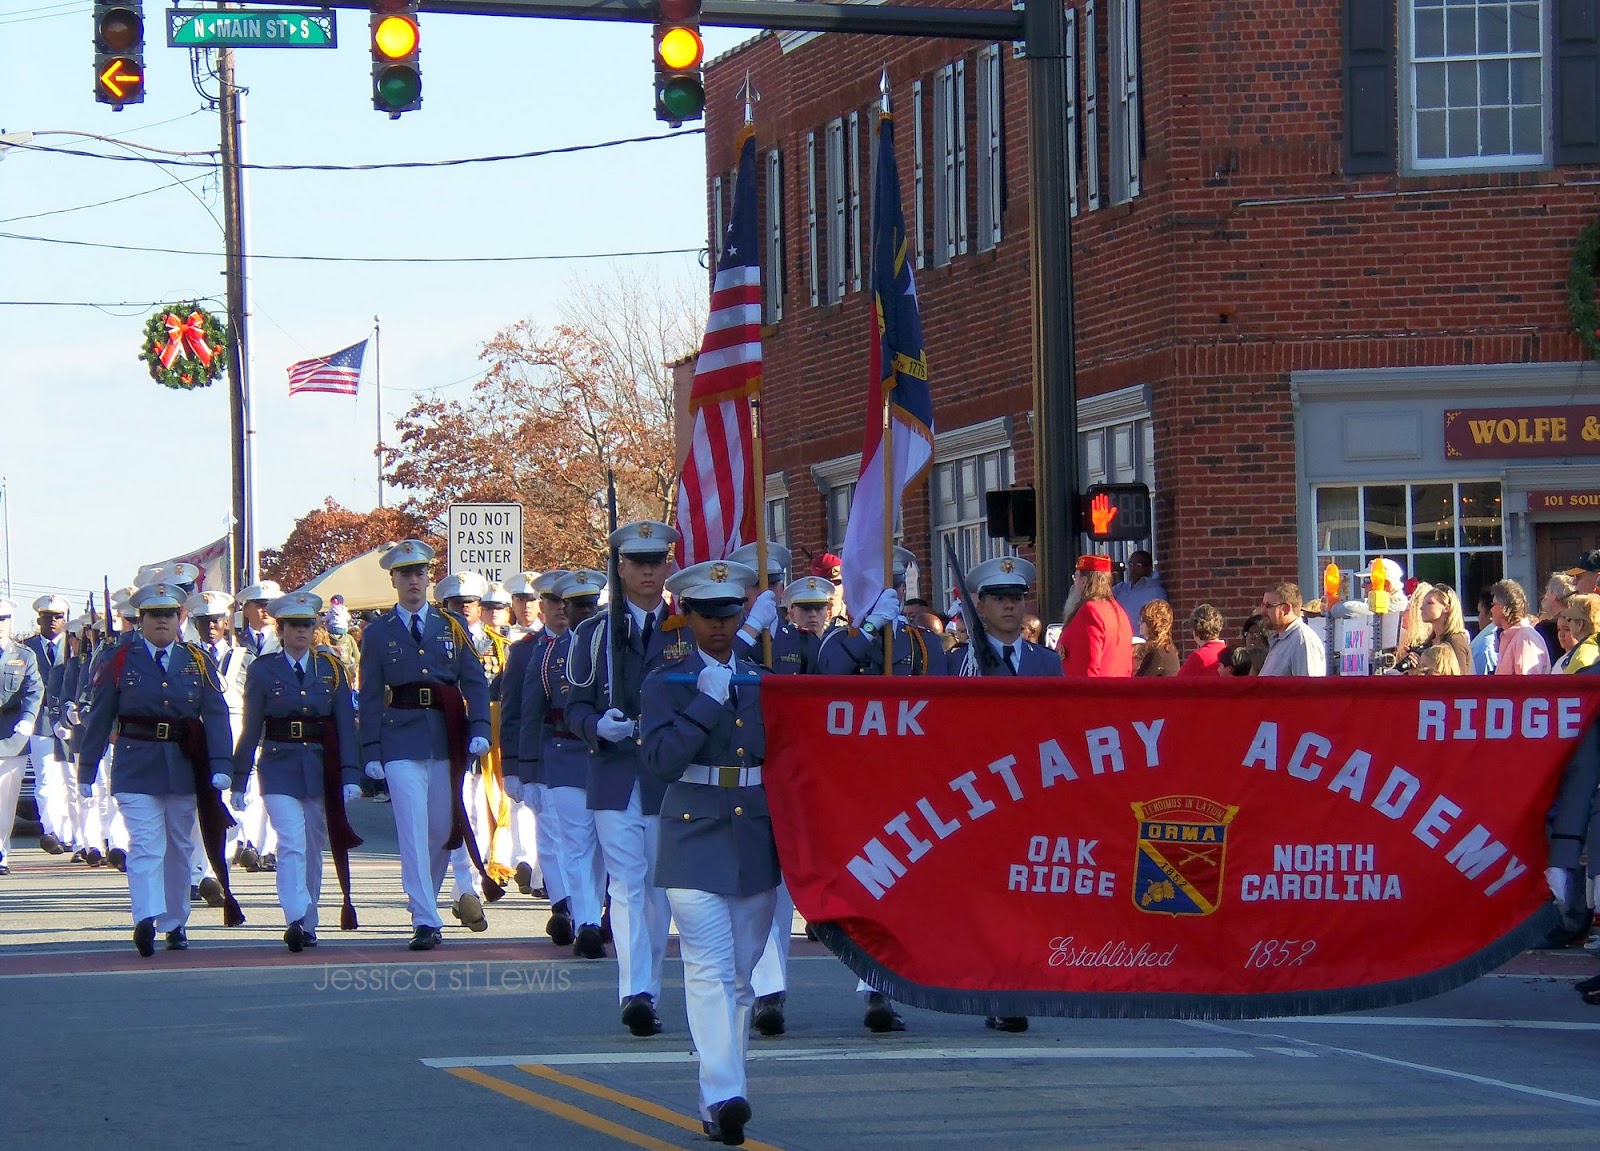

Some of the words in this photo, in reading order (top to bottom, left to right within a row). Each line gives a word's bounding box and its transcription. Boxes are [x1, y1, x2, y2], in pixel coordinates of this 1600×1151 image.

[195, 19, 204, 37] N
[217, 19, 260, 38] MAIN
[266, 20, 287, 38] ST
[300, 20, 309, 39] S
[909, 360, 925, 378] 1776
[1468, 417, 1566, 444] WOLFE
[1581, 415, 1600, 442] &
[1544, 495, 1563, 506] 101
[1569, 494, 1600, 506] SOU
[460, 512, 477, 526] DO
[484, 512, 511, 526] NOT
[457, 531, 494, 545] PASS
[501, 531, 513, 545] IN
[460, 550, 511, 563] CENTER
[826, 700, 929, 736] OAK
[1417, 697, 1581, 740] RIDGE
[845, 718, 1165, 900] MILITARY
[1241, 720, 1527, 897] ACADEMY
[1148, 824, 1216, 841] ORMA
[1027, 835, 1099, 866] OAK
[1273, 844, 1374, 872] NORTH
[1008, 864, 1116, 897] RIDGE
[1160, 862, 1187, 887] 1852
[1240, 873, 1402, 901] CAROLINA
[1048, 936, 1178, 967] Established
[1244, 939, 1316, 969] 1852
